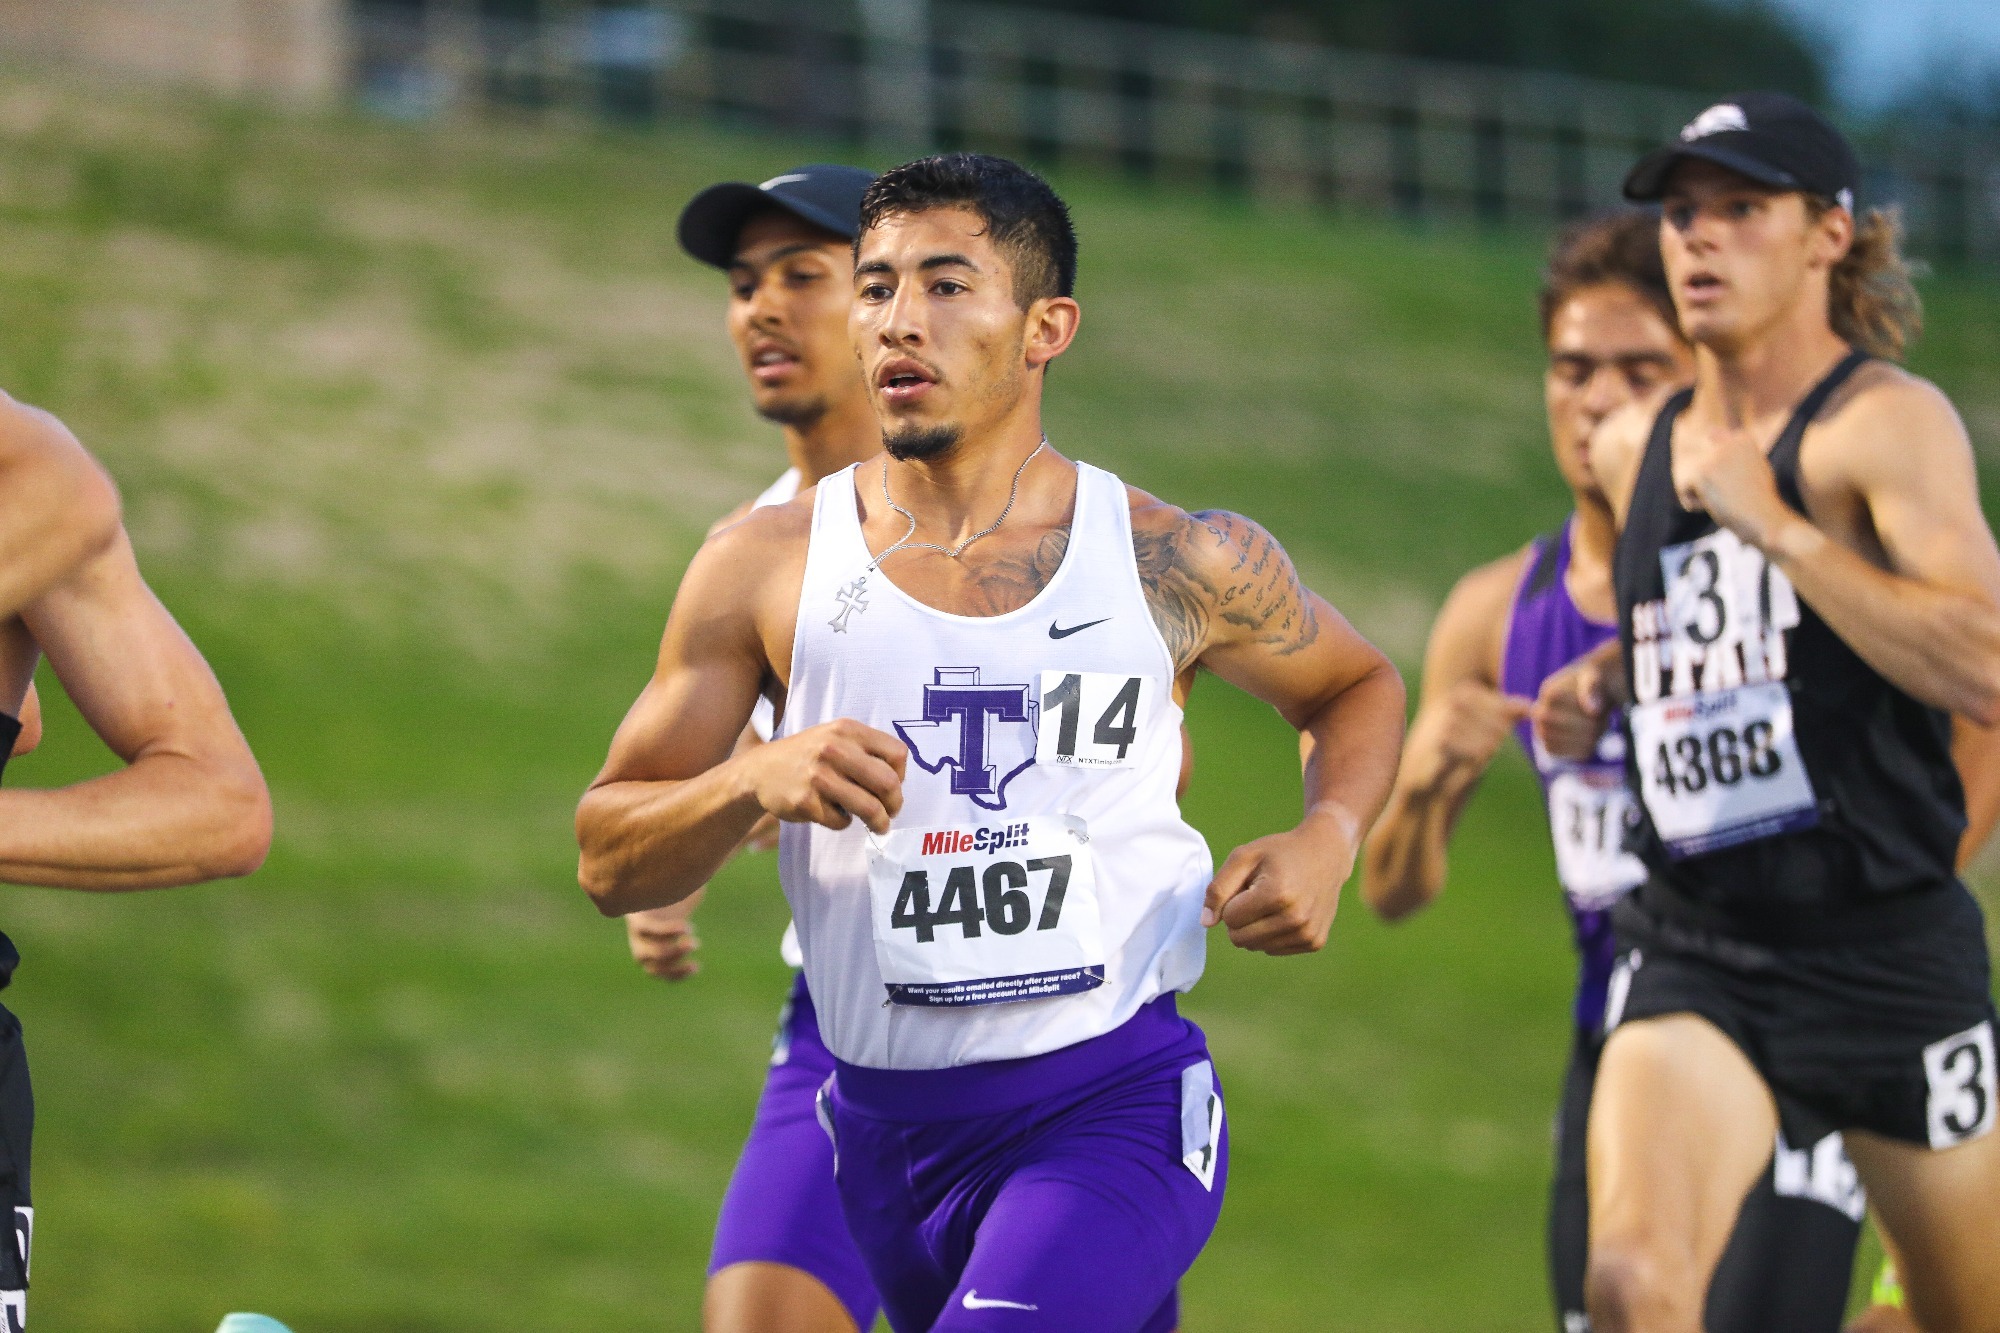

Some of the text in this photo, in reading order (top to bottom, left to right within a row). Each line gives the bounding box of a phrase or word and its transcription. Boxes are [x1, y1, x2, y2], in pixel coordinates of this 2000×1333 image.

[1043, 673, 1142, 759] 14
[921, 823, 1030, 855] MileSplit
[890, 854, 1073, 943] 4467
[928, 995, 943, 1003] Sign
[954, 994, 964, 1002] for
[987, 989, 1017, 999] account
[1018, 988, 1028, 996] on
[1028, 984, 1060, 994] MileSplit
[941, 985, 964, 994] results
[966, 982, 994, 992] emailed
[996, 979, 1023, 988] directly
[1024, 977, 1042, 985] after
[1043, 975, 1060, 984] your
[1060, 971, 1081, 981] race?
[1942, 1043, 1986, 1133] 3
